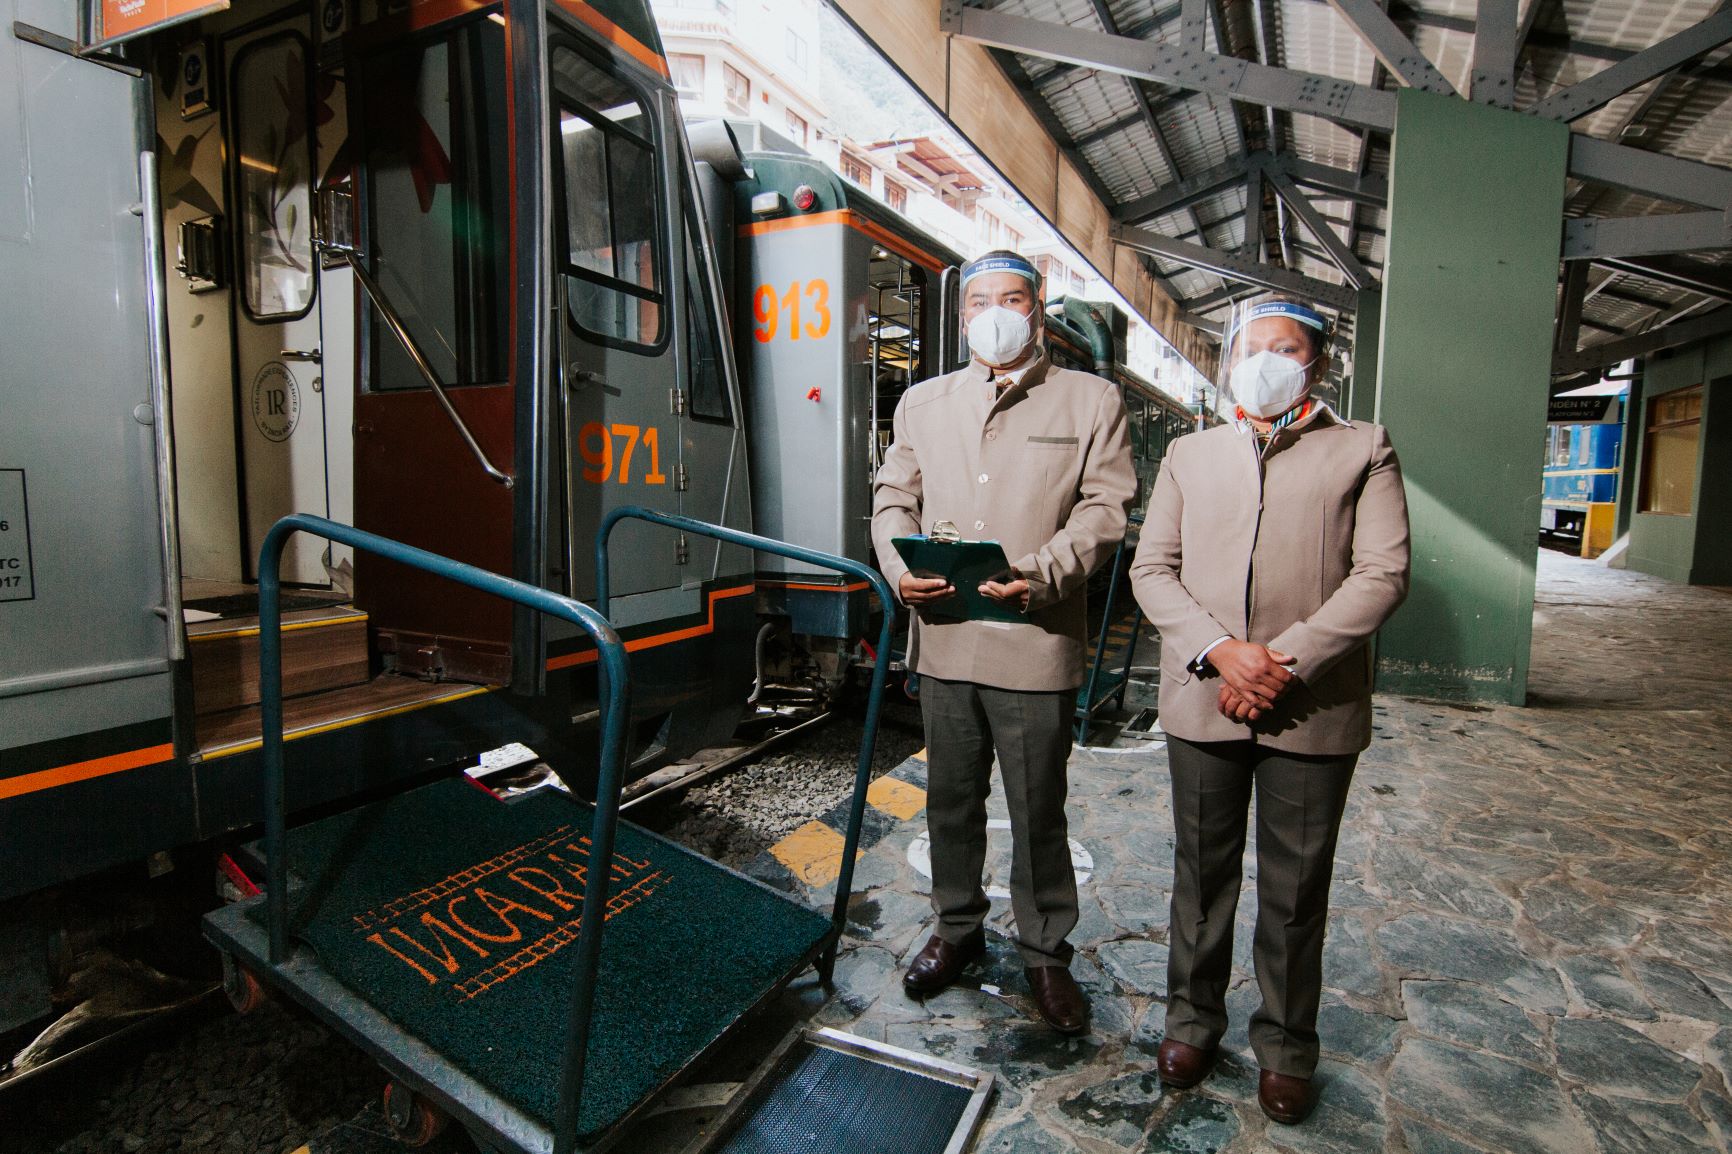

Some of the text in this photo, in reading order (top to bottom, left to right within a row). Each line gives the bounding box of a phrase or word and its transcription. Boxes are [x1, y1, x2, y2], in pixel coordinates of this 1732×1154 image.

[753, 279, 831, 343] 913
[266, 389, 286, 416] IR
[1594, 400, 1601, 408] 2
[579, 421, 666, 484] 971
[0, 576, 22, 588] 17
